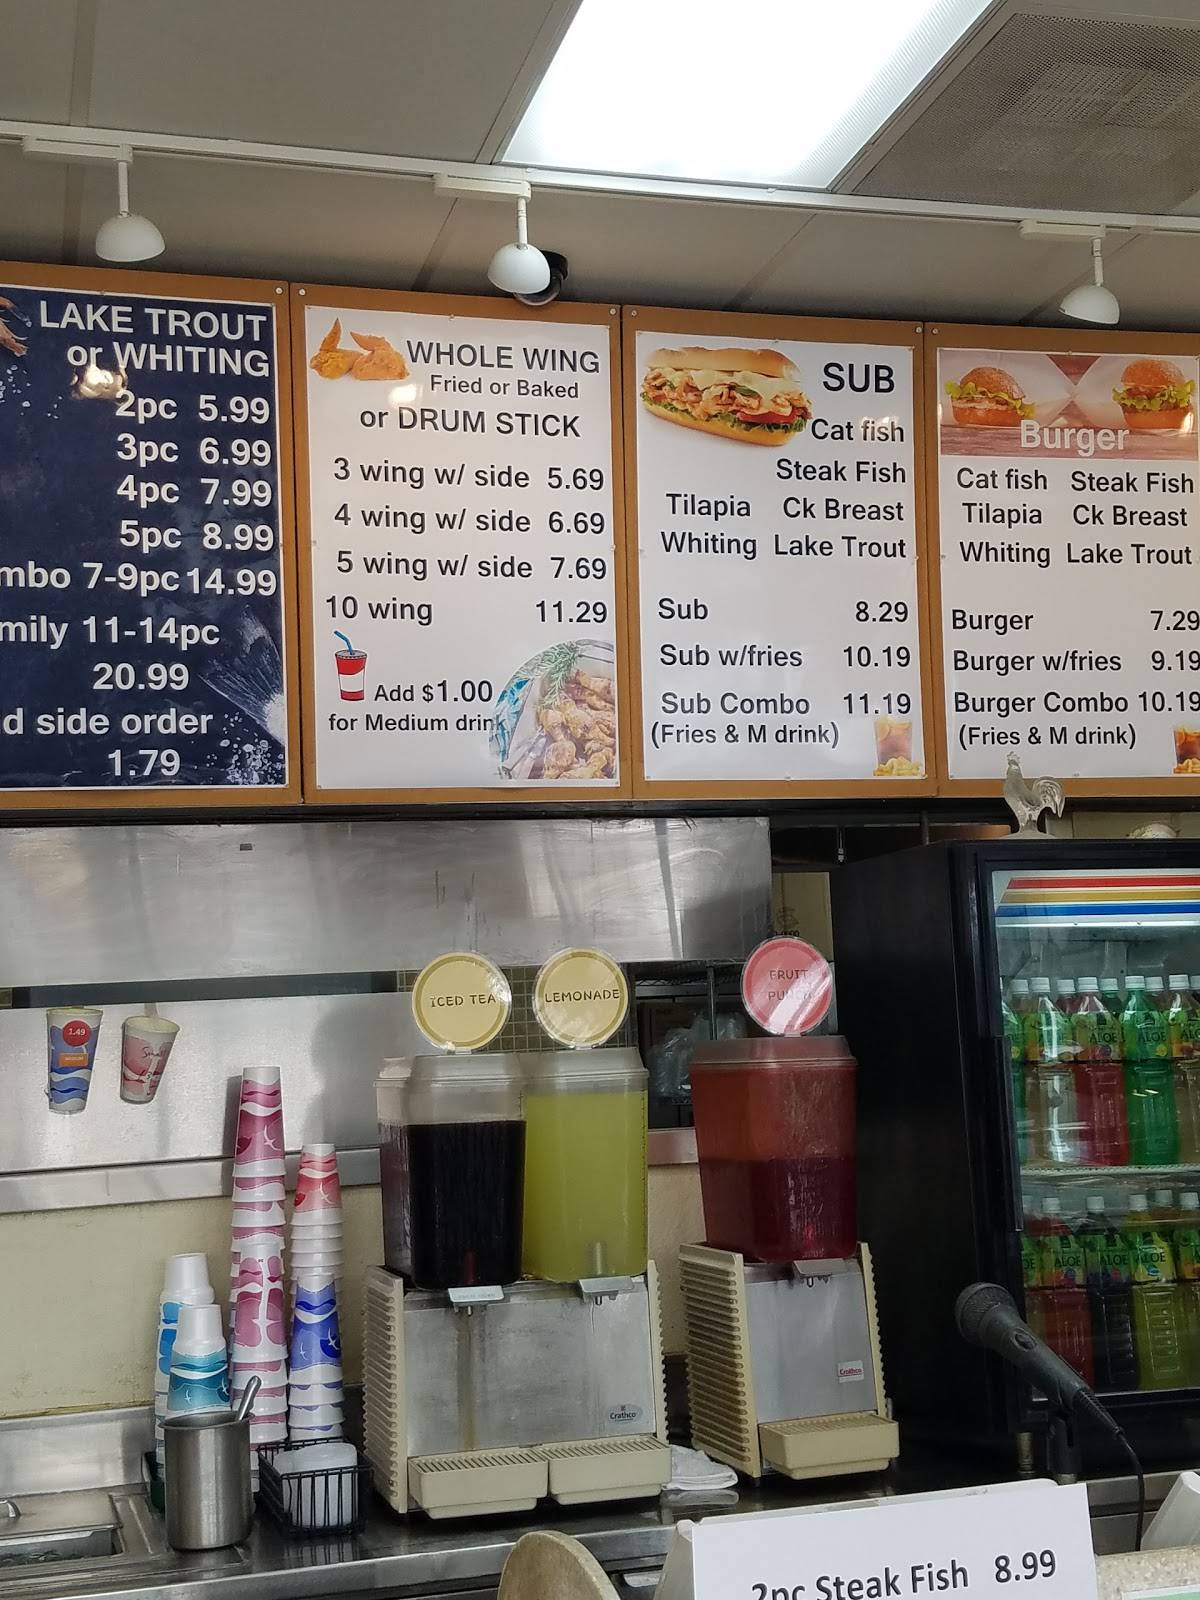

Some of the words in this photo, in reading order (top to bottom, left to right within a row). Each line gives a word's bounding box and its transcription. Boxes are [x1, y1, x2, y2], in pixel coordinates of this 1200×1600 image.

[40, 300, 133, 334] LAKE
[145, 308, 267, 341] TROUT
[67, 343, 102, 366] or
[113, 342, 270, 377] WHITING
[407, 339, 514, 369] WHOLE
[523, 347, 600, 374] WING
[430, 375, 482, 395] Fried
[489, 381, 511, 396] or
[517, 379, 579, 399] Baked
[822, 362, 895, 393] SUB
[115, 391, 177, 425] 2pc
[199, 395, 270, 424] 5.99
[360, 409, 388, 429] or
[399, 406, 486, 434] DRUM
[495, 412, 581, 438] STICK
[811, 418, 854, 443] Cat
[860, 419, 905, 443] fish
[116, 434, 179, 467] 3pc
[199, 438, 271, 466] 6.99
[1020, 420, 1129, 456] Burger
[334, 457, 350, 480] 3
[359, 459, 425, 488] wing
[434, 463, 464, 485] w/
[475, 466, 530, 488] side
[548, 468, 605, 490] 5.69
[776, 458, 847, 482] Steak
[856, 461, 906, 483] Fish
[957, 467, 998, 490] Cat
[1005, 469, 1047, 490] fish
[1071, 471, 1138, 492] Steak
[1146, 472, 1194, 494] Fish
[116, 475, 180, 509] 4pc
[201, 479, 272, 507] 7.99
[334, 503, 351, 526] 4
[361, 505, 426, 534] wing
[436, 508, 466, 530] w/
[475, 511, 531, 532] side
[548, 512, 605, 534] 6.69
[666, 494, 751, 519] Tilapia
[783, 497, 817, 519] Ck
[825, 499, 904, 521] Breast
[963, 503, 1043, 529] Tilapia
[1073, 505, 1105, 525] Ck
[1113, 506, 1188, 526] Breast
[120, 520, 182, 553] 5pc
[202, 524, 274, 551] 8.99
[661, 531, 757, 560] Whiting
[774, 534, 833, 557] Lake
[842, 536, 906, 558] Trout
[337, 551, 353, 573] 5
[363, 552, 428, 581] wing
[438, 555, 468, 577] w/
[478, 557, 533, 579] side
[550, 557, 607, 579] 7.69
[960, 541, 1051, 568] Whiting
[1067, 543, 1123, 564] Lake
[1131, 544, 1192, 565] Trout
[82, 563, 180, 596] 7-9pc
[187, 568, 277, 596] 14.99
[326, 596, 358, 619] 10
[368, 598, 433, 626] wing
[536, 601, 608, 623] 11.29
[658, 597, 708, 620] Sub
[855, 601, 908, 623] 8.29
[952, 609, 1033, 636] Burger
[1150, 611, 1200, 631] 7.29
[83, 615, 220, 650] 11-14pc
[660, 644, 710, 666] Sub
[718, 645, 802, 667] w/fries
[843, 646, 911, 667] 10.19
[953, 650, 1035, 676] Burger
[1043, 651, 1122, 672] w/fries
[1151, 651, 1200, 671] 9.19
[93, 662, 189, 691] 20.99
[374, 683, 414, 702] Add
[422, 680, 494, 704] $1.00
[661, 692, 711, 714] Sub
[720, 692, 810, 714] Combo
[843, 693, 911, 715] 11.19
[954, 692, 1036, 718] Burger
[1043, 691, 1129, 713] Combo
[1138, 692, 1200, 712] 10.19
[37, 708, 110, 735] side
[121, 708, 213, 735] order
[329, 713, 358, 732] for
[365, 714, 449, 731] Medium
[455, 714, 506, 732] drink
[651, 722, 716, 748] (Fries
[724, 724, 739, 744] &
[748, 725, 767, 744] M
[775, 723, 839, 748] drink)
[959, 724, 1020, 748] (Fries
[1027, 726, 1042, 745] &
[1049, 727, 1068, 745] M
[1075, 724, 1137, 749] drink)
[108, 749, 180, 776] 1.79
[770, 970, 808, 980] FRUIT
[431, 996, 463, 1008] ICED
[469, 994, 496, 1005] TEA
[545, 989, 620, 1003] LEMONADE
[68, 1028, 86, 1036] 1.49
[1090, 1033, 1117, 1043] ALOE
[1055, 1256, 1081, 1267] ALOE
[1101, 1255, 1129, 1265] ALOE
[815, 1567, 901, 1600] Steak
[911, 1560, 968, 1595] Fish
[995, 1549, 1056, 1584] 8.99
